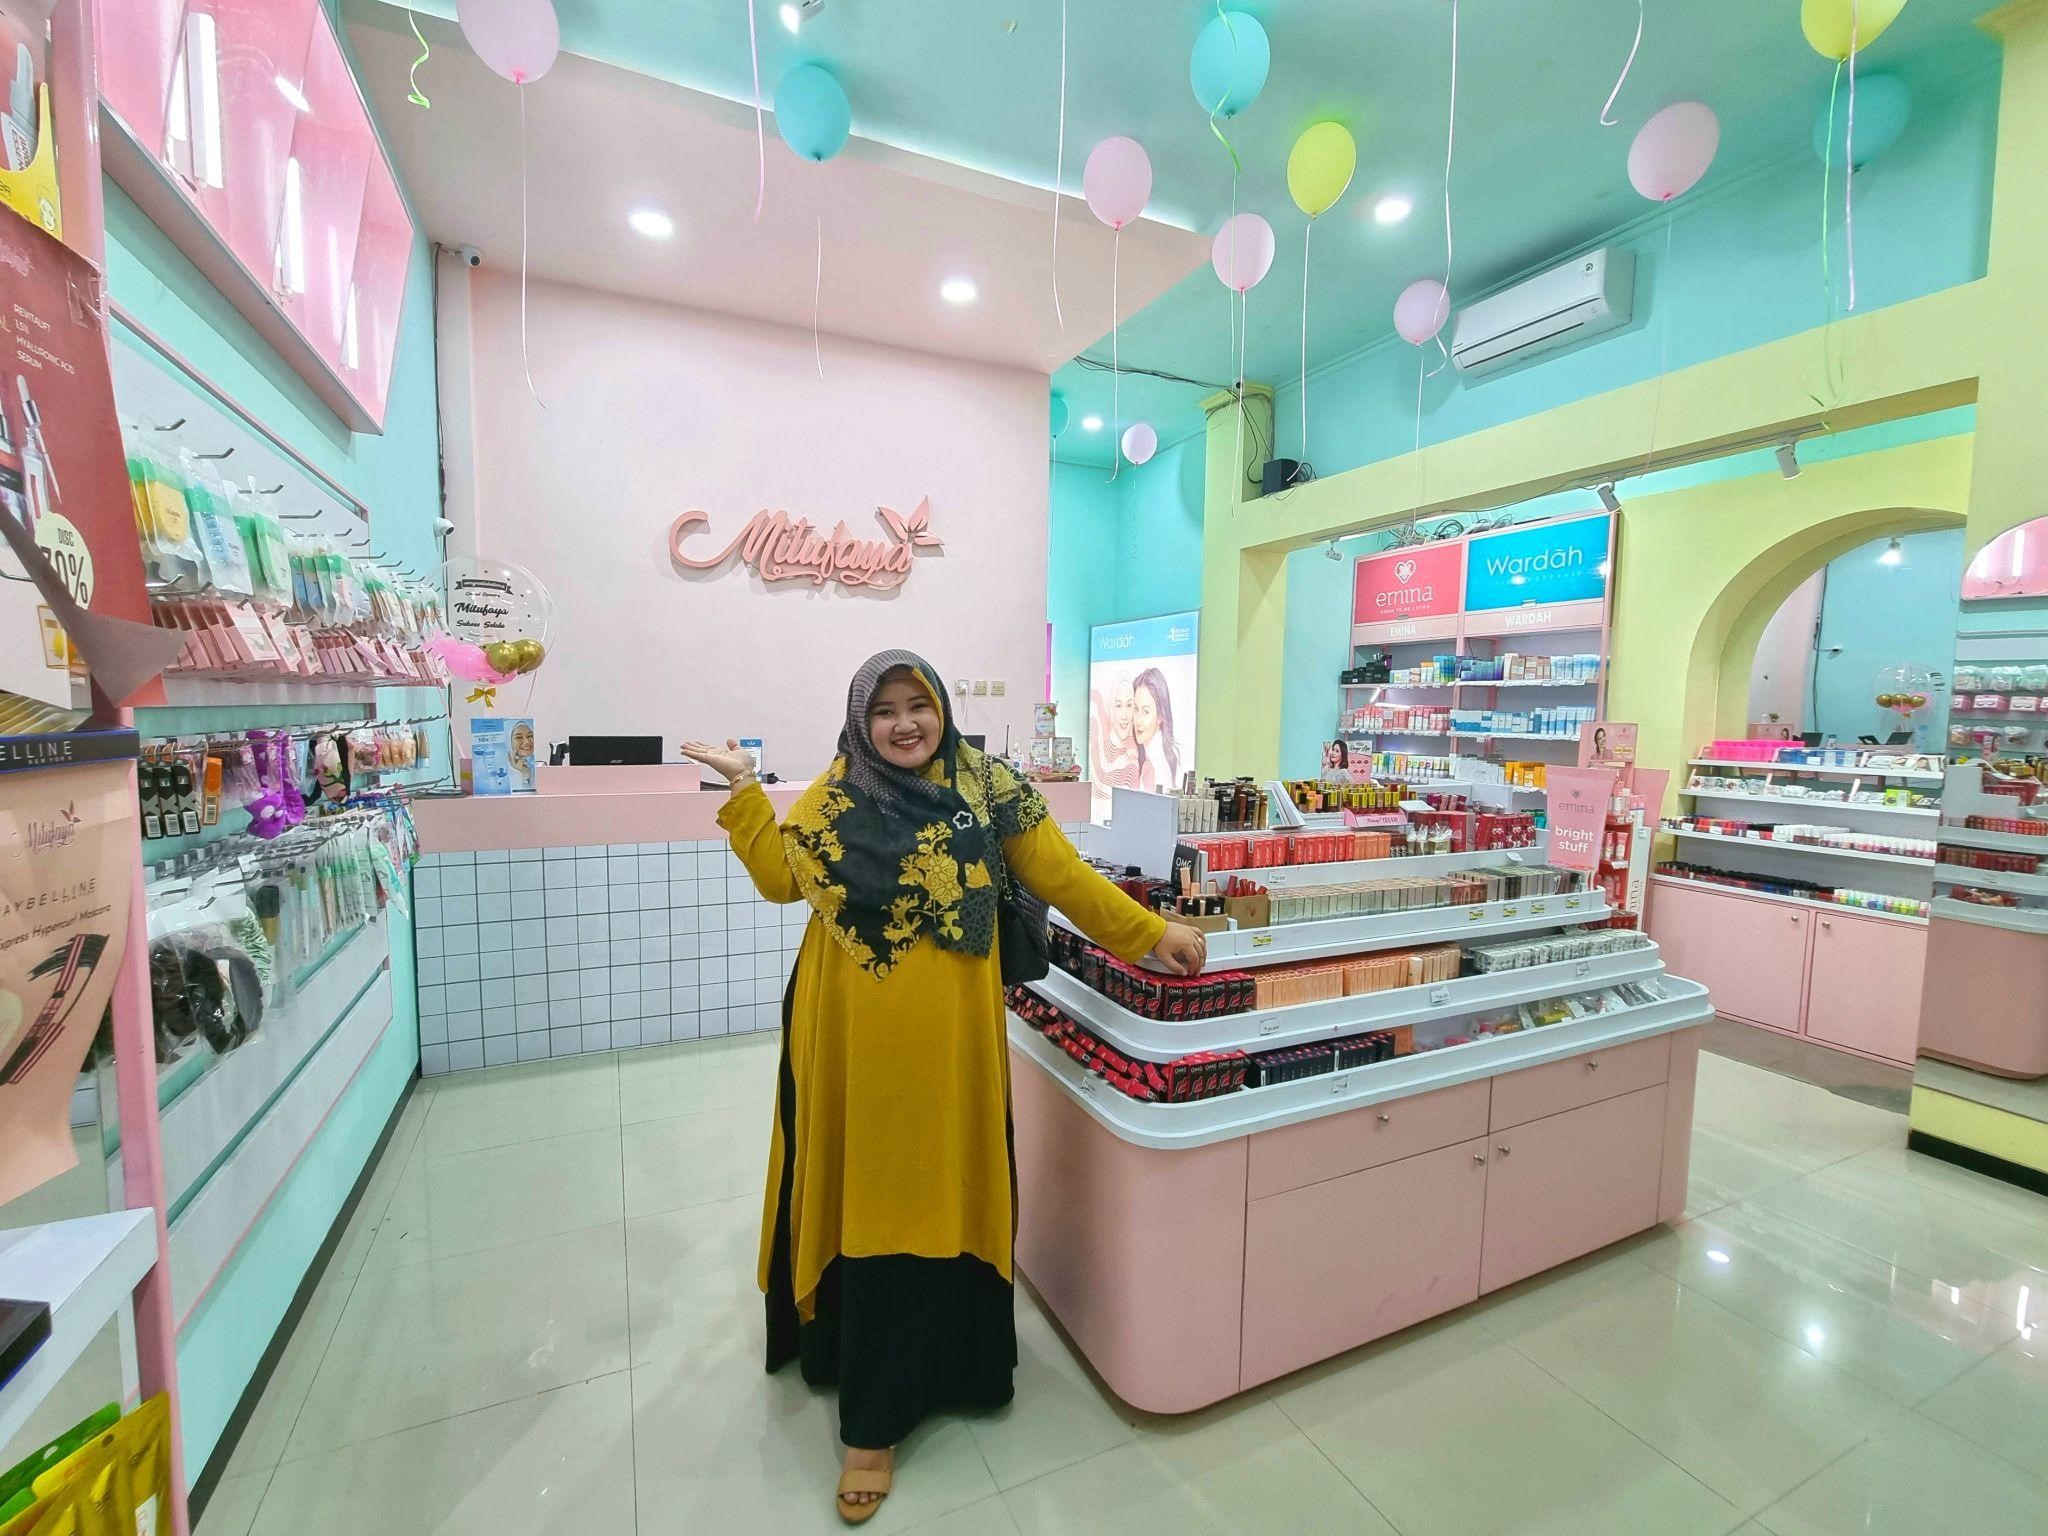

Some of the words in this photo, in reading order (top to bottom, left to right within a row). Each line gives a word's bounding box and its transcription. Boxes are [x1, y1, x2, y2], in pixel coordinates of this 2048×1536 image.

[1375, 585, 1434, 607] emina
[454, 602, 509, 619] Mitufaya
[1505, 611, 1552, 627] WARDAH
[1390, 623, 1417, 637] EMINA
[1558, 801, 1595, 814] emina
[1555, 825, 1594, 841] bright
[1559, 841, 1589, 854] stuff
[1175, 856, 1192, 868] OMG
